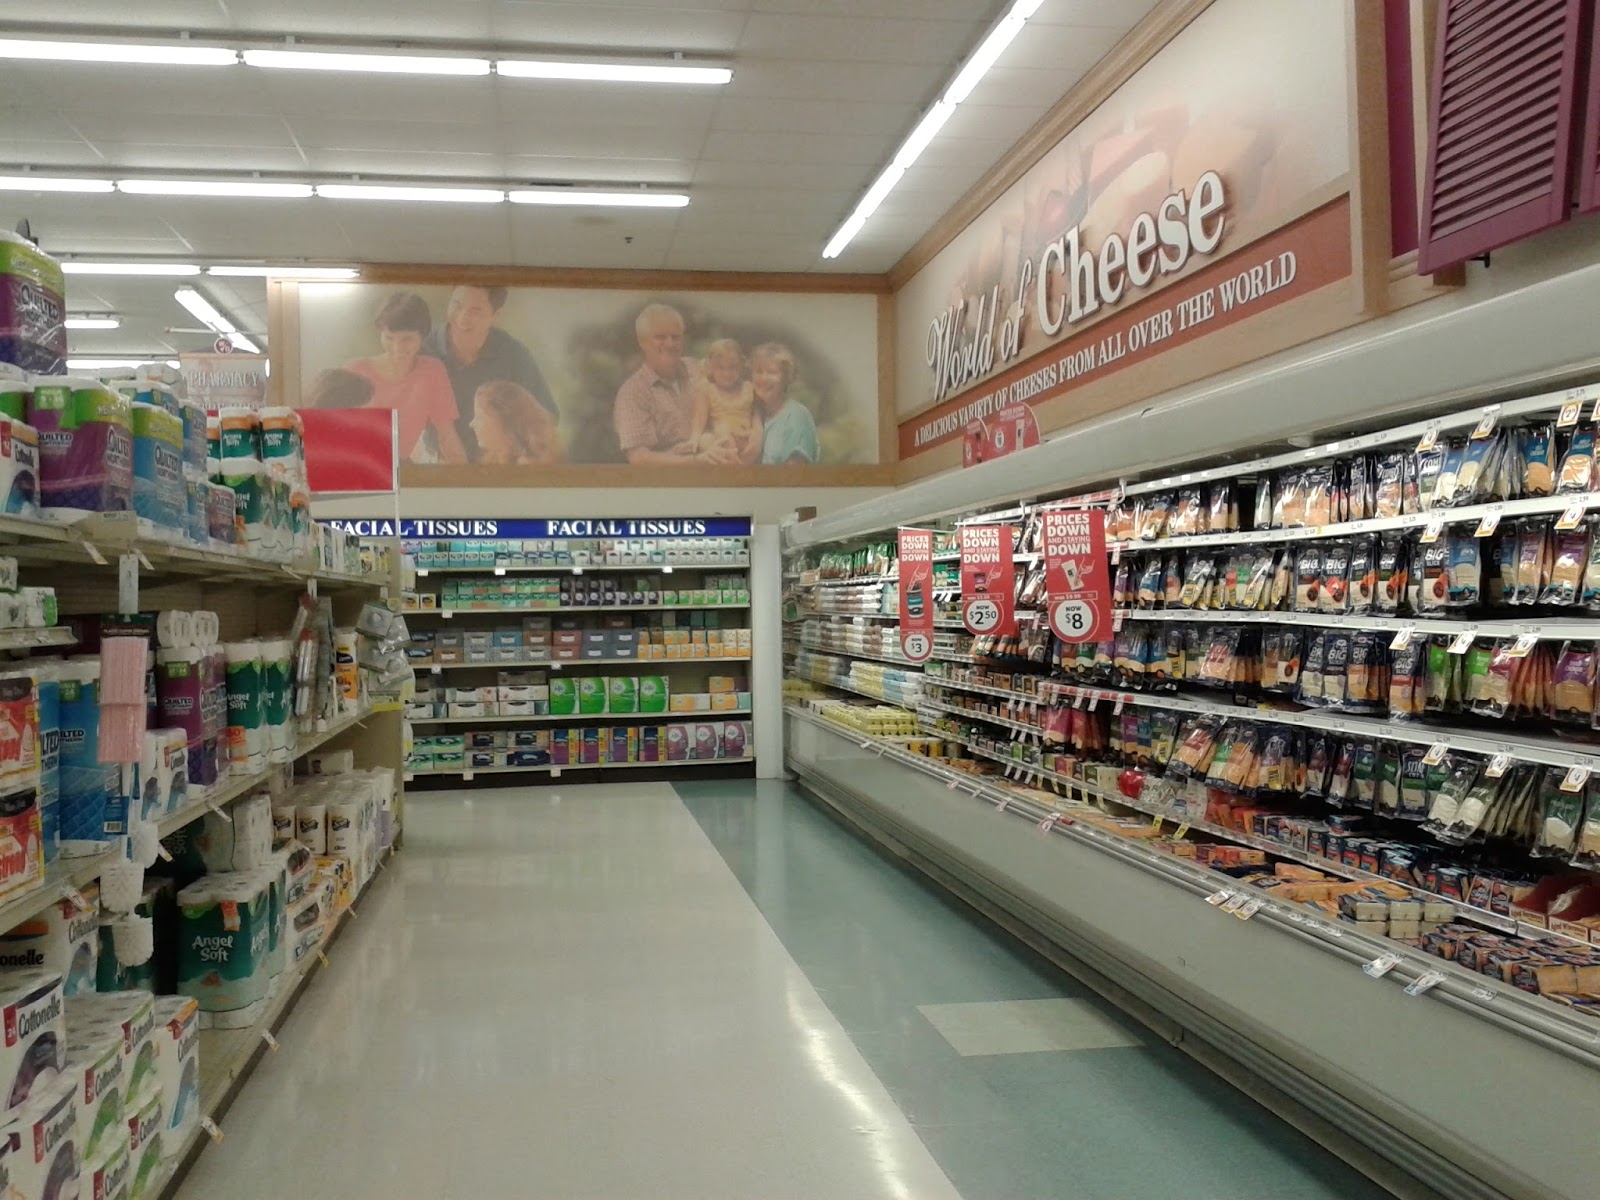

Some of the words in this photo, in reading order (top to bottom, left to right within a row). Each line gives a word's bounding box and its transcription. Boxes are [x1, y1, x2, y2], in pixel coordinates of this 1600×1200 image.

[927, 285, 998, 401] World
[1000, 258, 1032, 361] of
[1037, 170, 1225, 335] Cheese
[920, 410, 960, 444] DELICIOUS
[959, 393, 994, 426] VARIETY
[995, 387, 1008, 411] OF
[1010, 364, 1057, 403] CHEESES
[1059, 344, 1095, 383] FROM
[1098, 332, 1126, 366] ALL
[1129, 308, 1174, 352] OVER
[1177, 288, 1215, 332] THE
[1219, 251, 1297, 313] WORLD
[190, 371, 261, 388] PHARMACY
[1046, 513, 1090, 526] PRICES
[413, 520, 498, 536] TISSUES
[547, 520, 622, 536] FACIAL
[626, 520, 706, 536] TISSUES
[962, 529, 999, 539] PRICES
[1047, 524, 1090, 537] DOWN
[901, 535, 929, 543] PRICES
[963, 538, 999, 548] DOWN
[1062, 536, 1091, 544] STAYING
[901, 542, 929, 550] DOWN
[1048, 543, 1091, 556] DOWN
[963, 554, 1000, 564] DOWN
[1425, 549, 1444, 560] BIG
[1326, 558, 1347, 569] BIG
[1328, 649, 1348, 660] BIG
[229, 700, 248, 710] Soft
[192, 935, 234, 949] Angel
[200, 948, 229, 962] Soft
[18, 993, 61, 1039] Cottonelle
